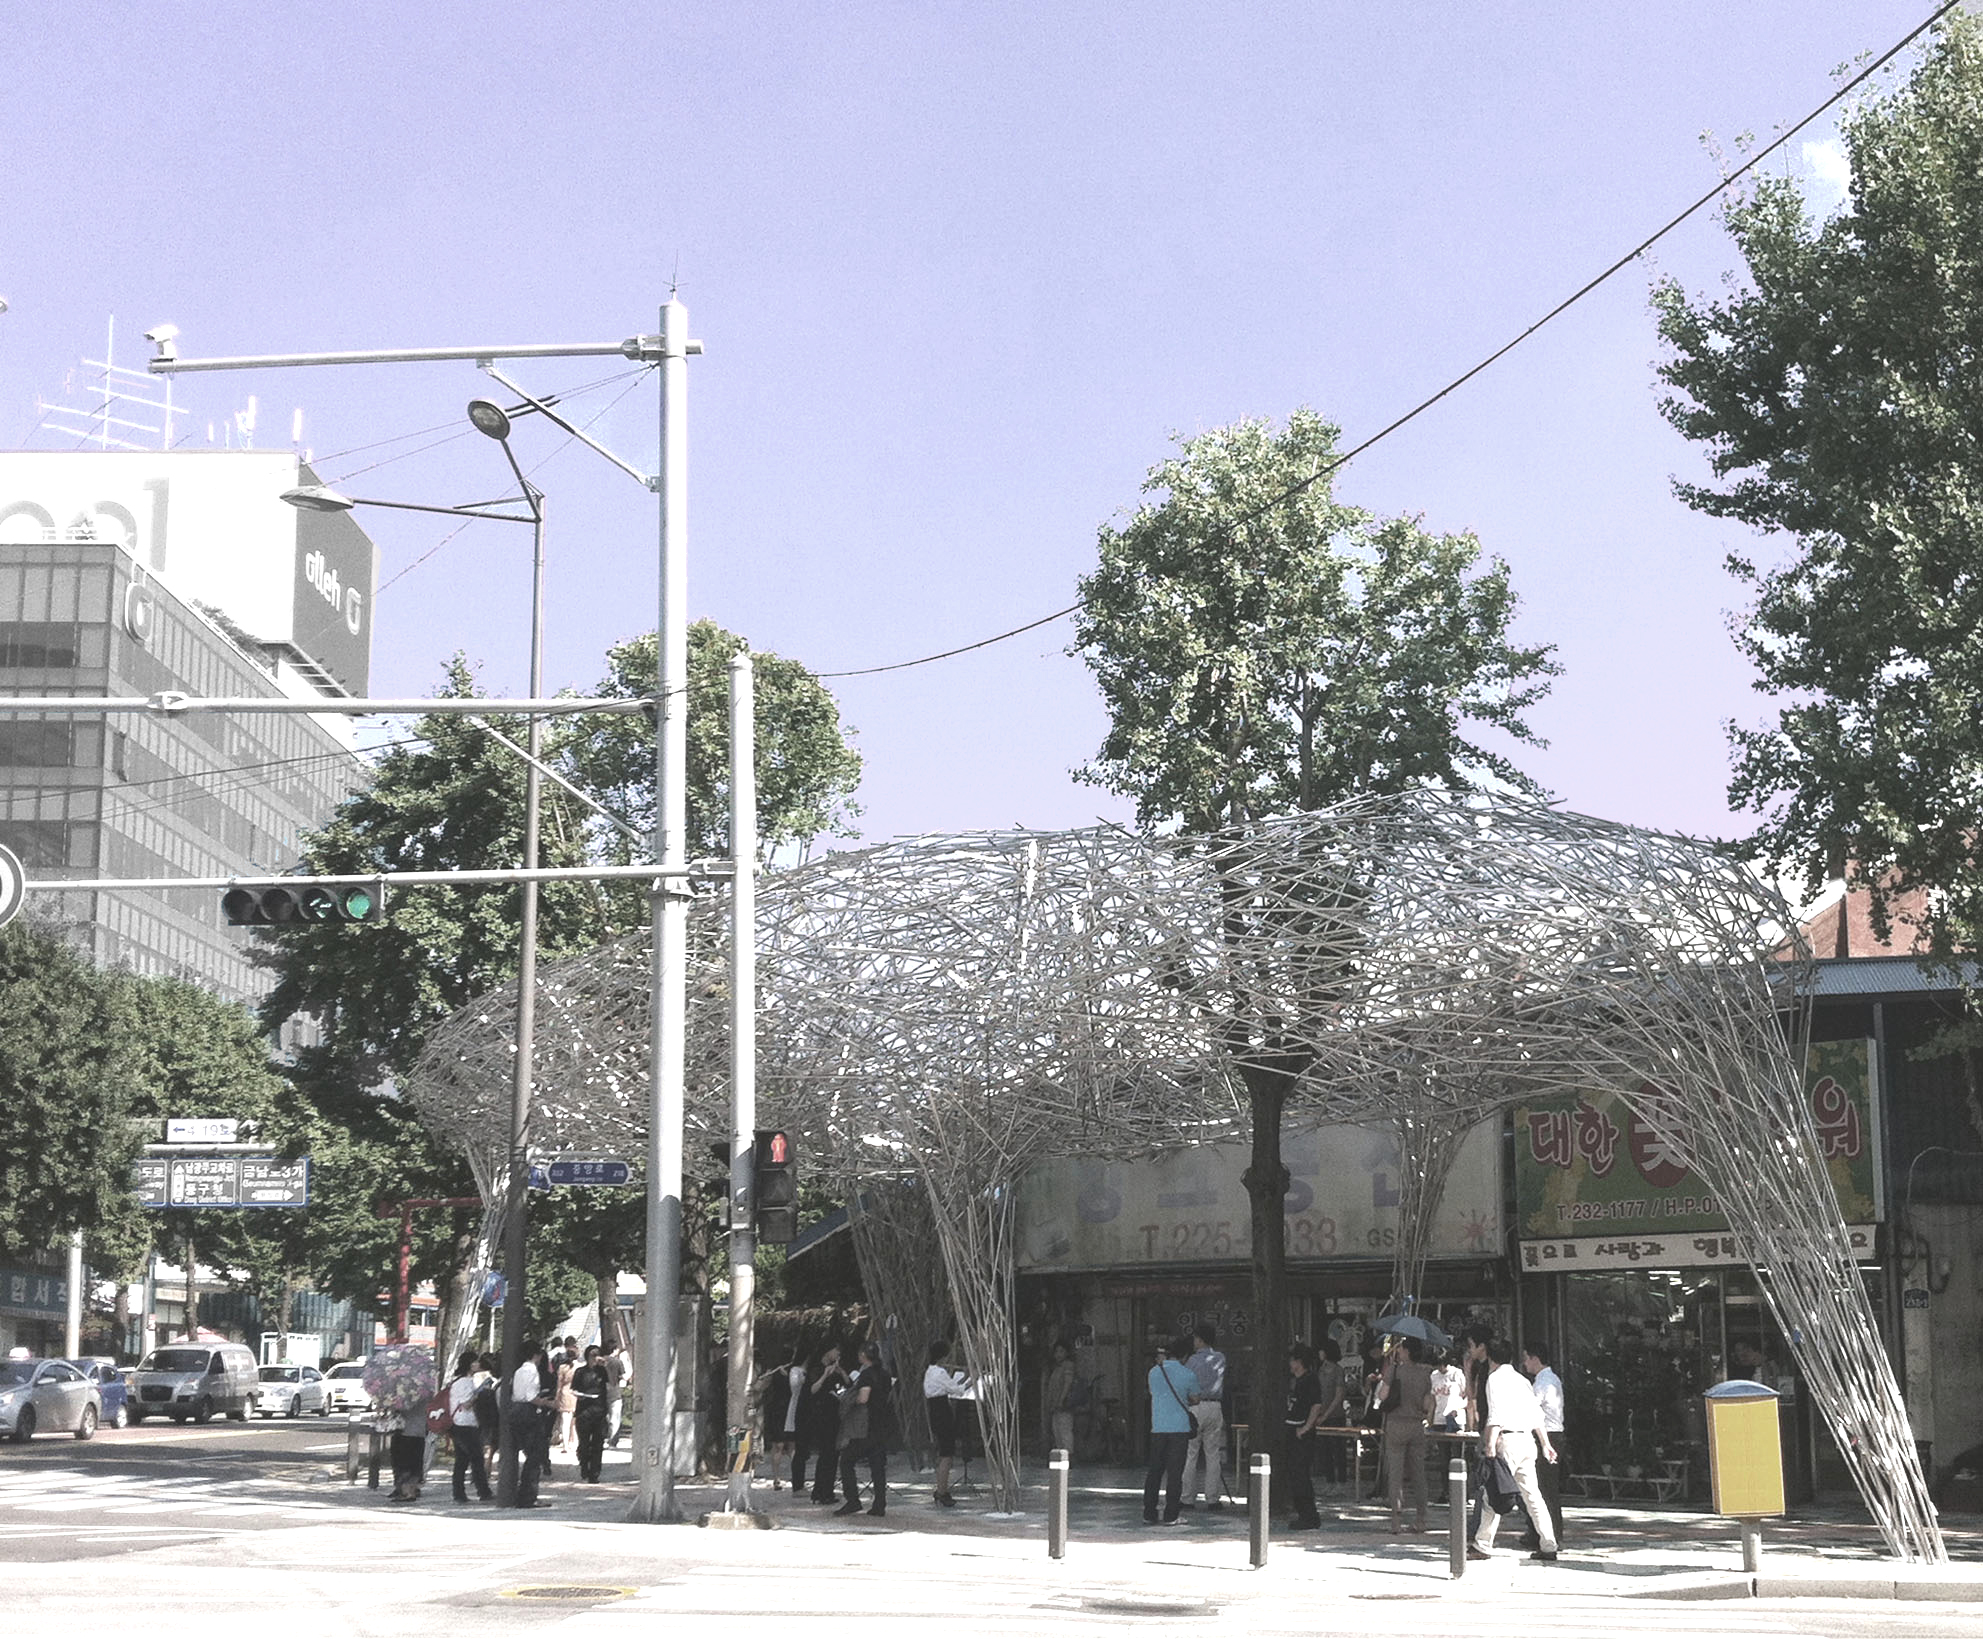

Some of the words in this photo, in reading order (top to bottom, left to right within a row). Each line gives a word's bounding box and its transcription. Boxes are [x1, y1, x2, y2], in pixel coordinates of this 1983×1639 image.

[305, 549, 341, 612] olleh
[1556, 1201, 1646, 1222] T.232-1177
[1523, 1243, 1578, 1267] 꽃으로
[1594, 1241, 1666, 1261] 사랑과
